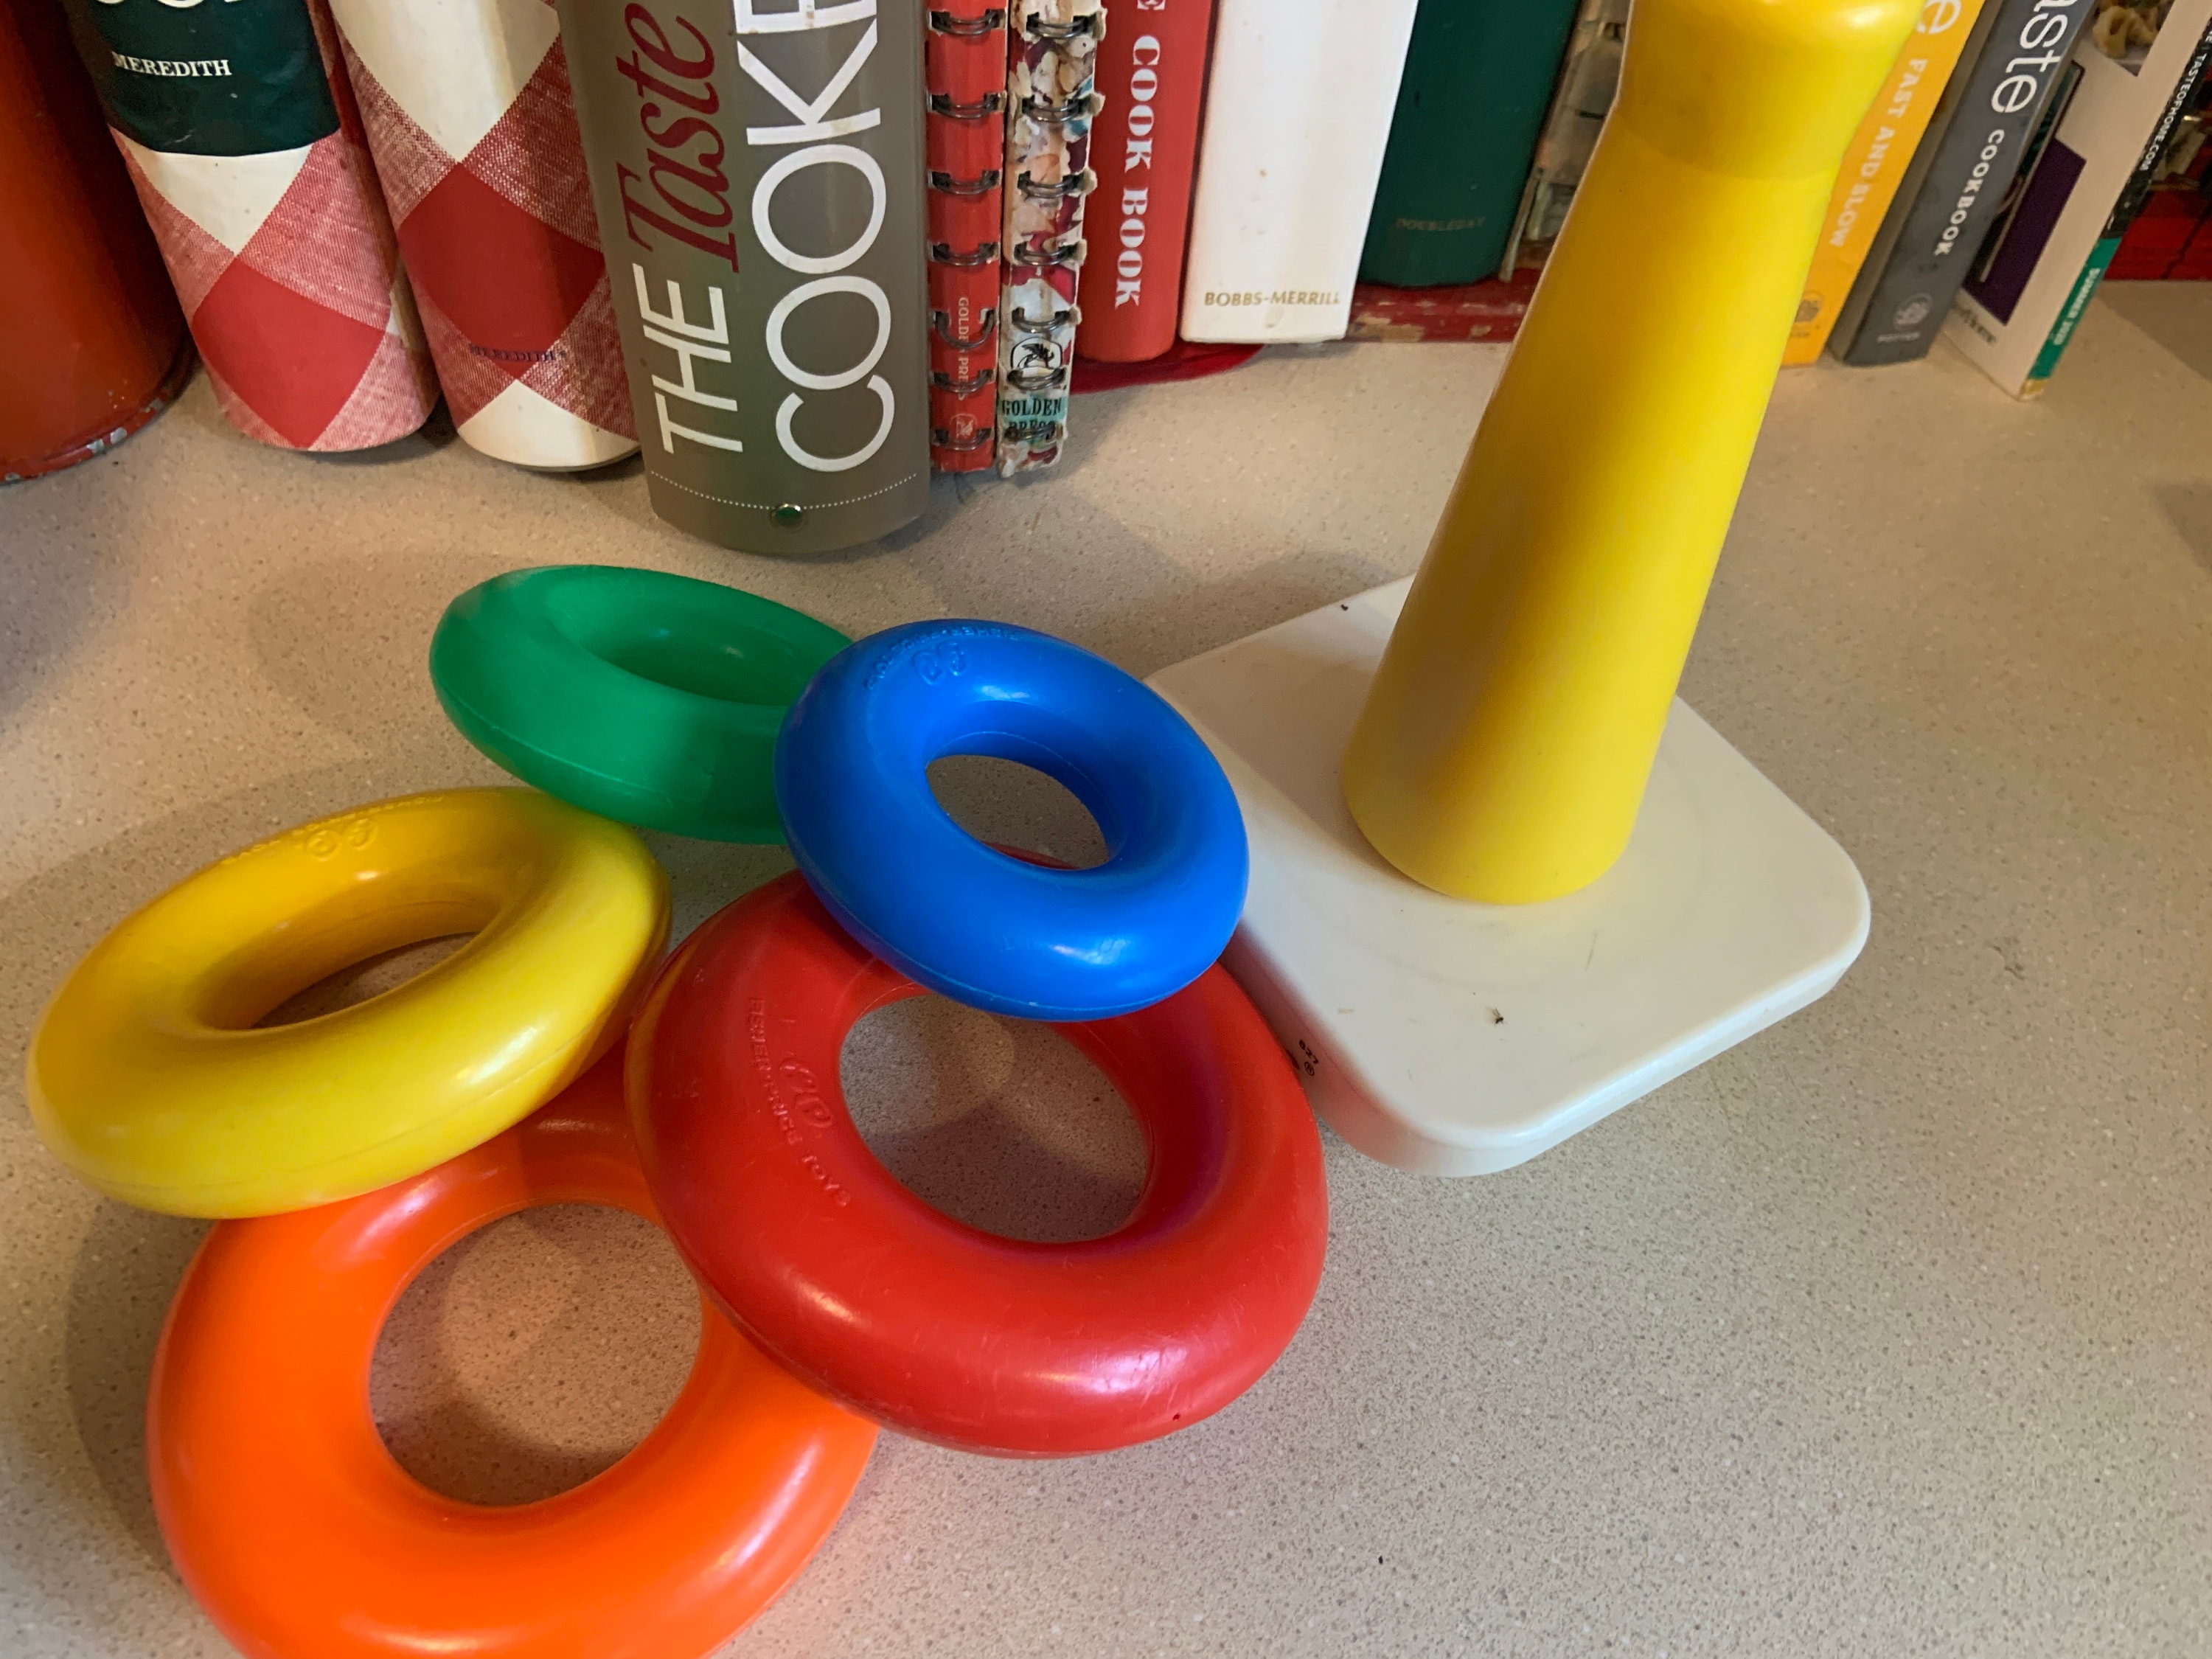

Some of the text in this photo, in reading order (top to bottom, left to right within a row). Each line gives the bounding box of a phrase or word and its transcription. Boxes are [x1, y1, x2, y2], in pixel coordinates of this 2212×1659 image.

[111, 51, 232, 77] MEREDITH
[1888, 58, 1928, 118] FAST
[1124, 35, 1161, 174] COOK
[2139, 53, 2208, 171] TASTEOFHOME.COM
[1860, 126, 1896, 178] AND
[1829, 183, 1871, 247] SLOW
[1933, 129, 2005, 256] COOKBOOK
[616, 2, 743, 454] THE Taste
[1115, 187, 1149, 310] BOOK
[958, 297, 970, 354] GOLDE
[1204, 291, 1341, 307] BOBBS-MERRILL
[1002, 397, 1062, 417] GOLDEN
